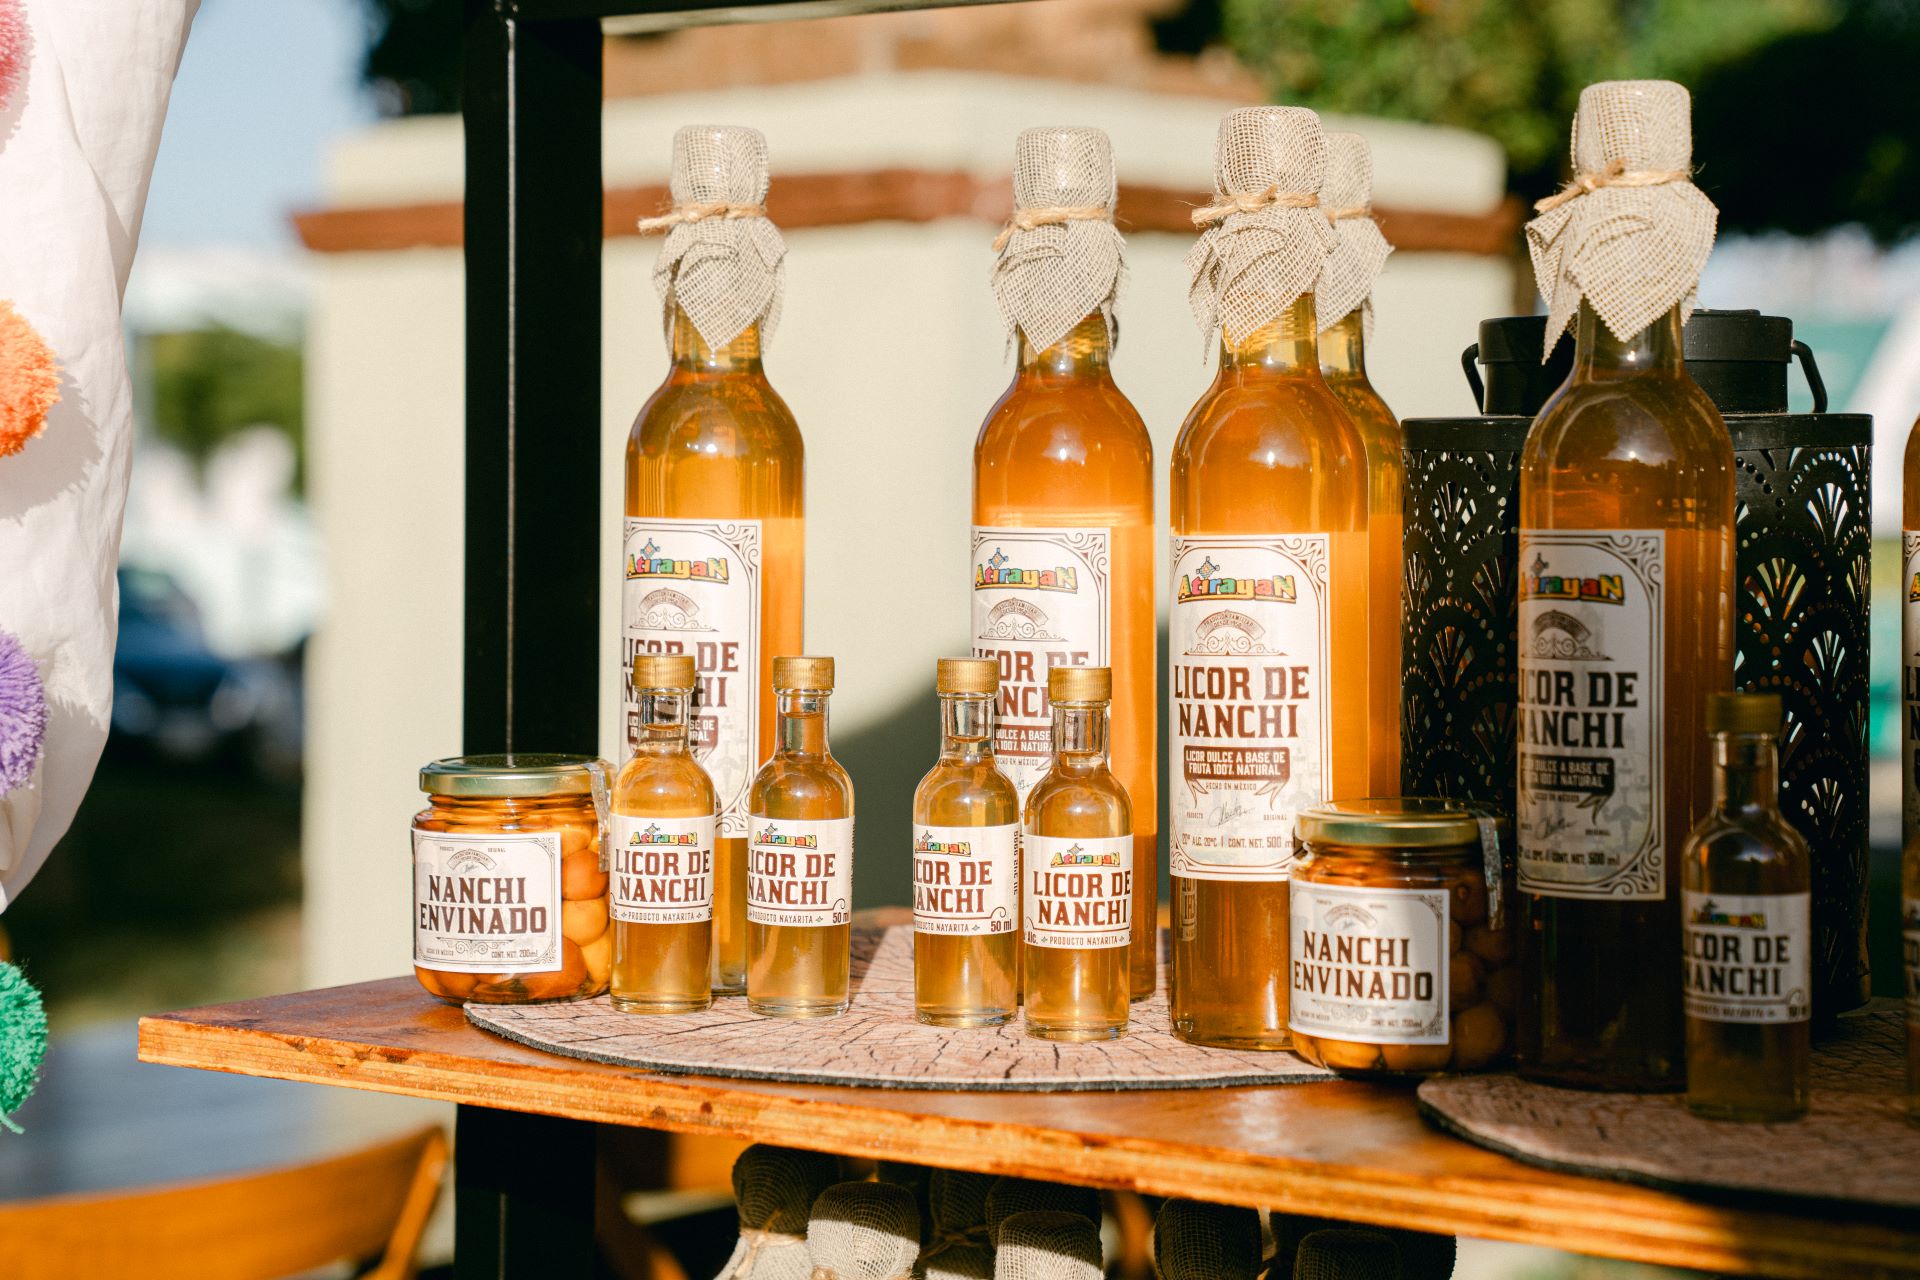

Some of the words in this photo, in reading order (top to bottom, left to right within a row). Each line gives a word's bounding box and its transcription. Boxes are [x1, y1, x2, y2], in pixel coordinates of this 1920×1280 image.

[696, 641, 739, 672] DE
[1174, 665, 1252, 700] LICOR
[1263, 665, 1309, 700] DE
[1588, 671, 1638, 708] DE
[703, 720, 715, 730] DE
[1179, 703, 1298, 738] NANCHI
[1020, 730, 1027, 741] A
[1028, 730, 1051, 741] BASE
[1186, 750, 1206, 762] LICOR
[1207, 751, 1233, 763] DULCE
[1236, 752, 1243, 763] A
[1245, 752, 1270, 764] BASE
[1273, 752, 1286, 764] DE
[1188, 762, 1212, 775] FRUTA
[1237, 764, 1281, 776] NATURAL
[1228, 838, 1247, 849] CONT.
[1249, 838, 1265, 849] NET.
[1267, 836, 1282, 849] 500
[615, 848, 679, 876] LICOR
[688, 849, 710, 875] DE
[805, 853, 836, 878] DE
[959, 860, 993, 886] DE
[429, 874, 526, 905] NANCHI
[619, 876, 705, 903] NANCHI
[1033, 870, 1104, 898] LICOR
[1111, 870, 1131, 897] DE
[420, 902, 547, 935] ENVINADO
[628, 913, 660, 922] PRODUCTO
[663, 912, 695, 922] NAYARITA
[779, 915, 813, 924] NAYARITA
[832, 912, 842, 923] 50
[936, 922, 969, 932] NAYARITA
[990, 920, 1001, 932] 50
[1003, 919, 1012, 931] ml
[1038, 899, 1127, 926] NANCHI
[1049, 936, 1084, 946] PRODUCTO
[1087, 936, 1118, 946] NAYARITA
[1303, 930, 1410, 967] NANCHI
[1754, 935, 1790, 964] DE
[1294, 960, 1433, 1001] ENVINADO
